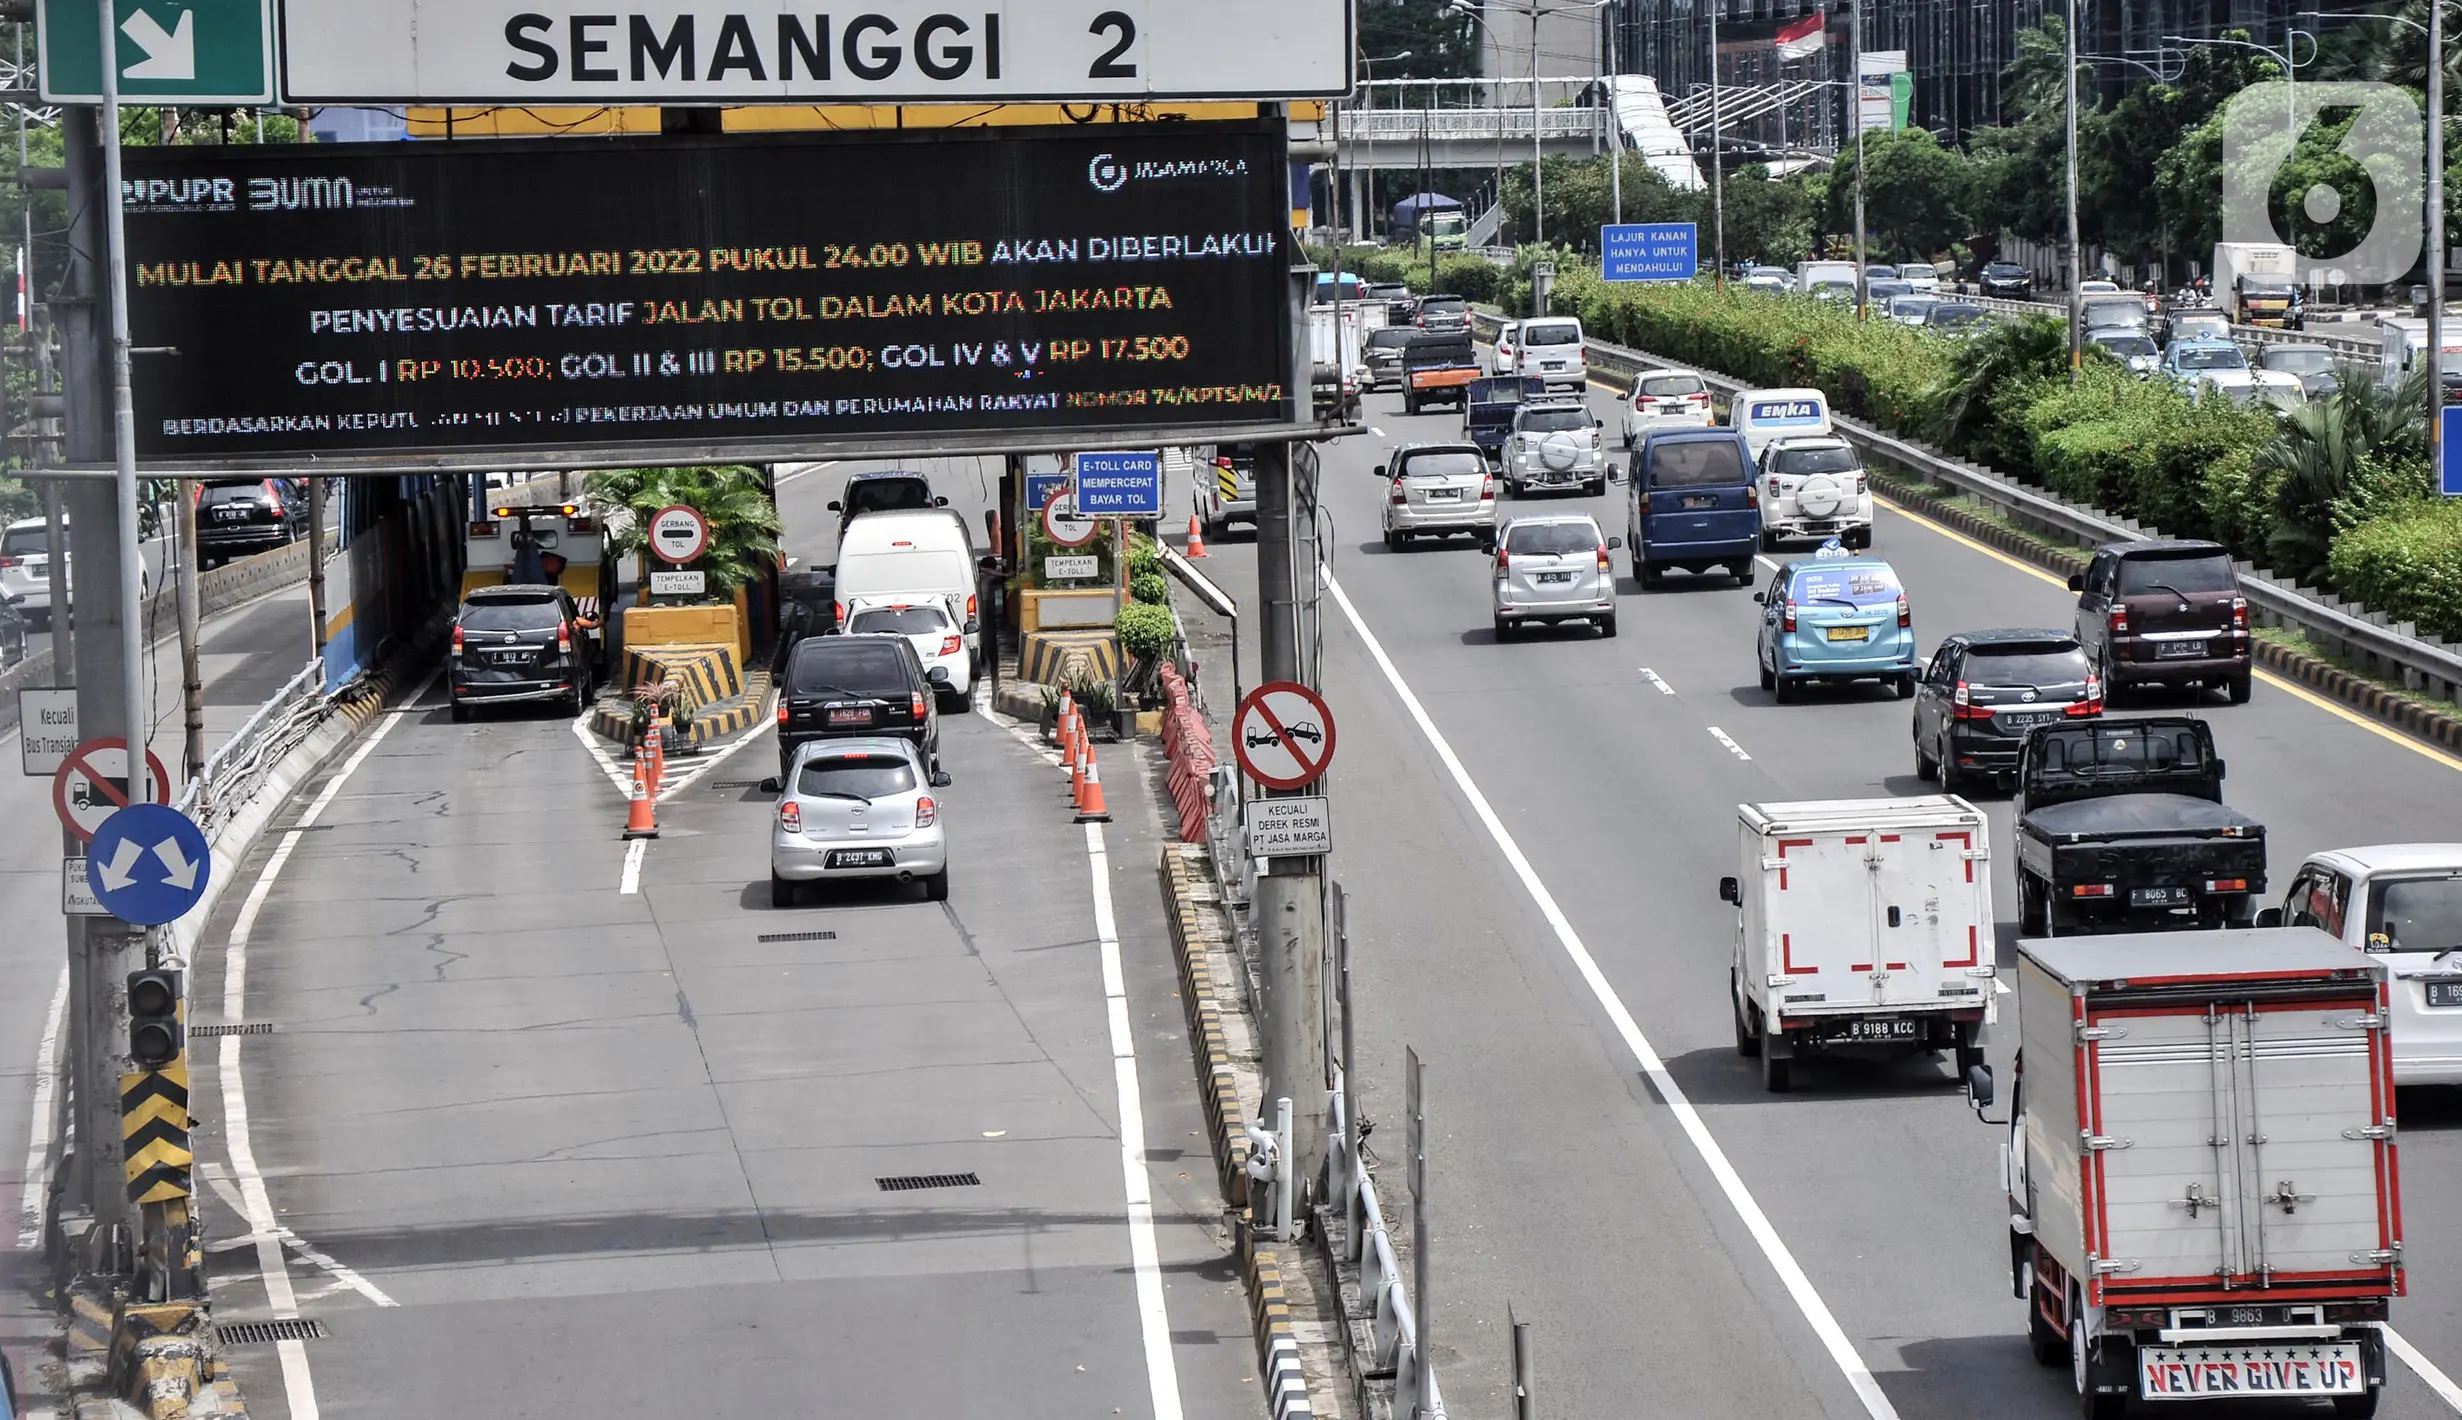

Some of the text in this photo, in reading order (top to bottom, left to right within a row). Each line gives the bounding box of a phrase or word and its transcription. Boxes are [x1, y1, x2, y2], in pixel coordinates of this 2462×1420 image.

[505, 11, 1137, 82] SEMANGGI 2
[1611, 231, 1687, 243] LAJUR KANAN
[1611, 246, 1688, 258] HANYA UNTUK
[136, 259, 243, 287] MULAI
[250, 255, 408, 284] TANGGAL
[413, 254, 452, 280] 26
[460, 251, 621, 278] FEBRUARI
[629, 248, 702, 274] 2022
[709, 245, 817, 271] PUKUL
[824, 243, 910, 269] 24.00
[916, 240, 984, 266] WIB
[991, 238, 1078, 262] AKAN
[1616, 262, 1683, 273] MENDAHULUI
[310, 285, 1173, 333] PENYESUAIAN TARIF JALAN TOL DALAM KOTA JAKARTA
[296, 361, 372, 384] GOL.
[396, 359, 441, 382] RP
[561, 353, 626, 379] GOL
[633, 352, 650, 377] II
[659, 350, 680, 377] &
[689, 349, 715, 375] III
[724, 349, 766, 372] RP
[773, 345, 875, 373] 15.500;
[881, 344, 945, 368] GOL
[953, 342, 983, 366] IV
[990, 340, 1013, 366] &
[1020, 342, 1041, 364] V
[1050, 339, 1091, 361] RP
[1100, 335, 1190, 361] 17.500
[162, 415, 330, 435] BERDASARKAN
[783, 400, 829, 417] DAN
[835, 395, 973, 415] PERUMAHAN
[980, 392, 1060, 411] RAKYAT
[1761, 402, 1811, 419] EMKA
[1083, 461, 1152, 471] E-TOLL CARD
[1083, 478, 1153, 488] MEMPERCEPAT
[1090, 494, 1146, 504] BAYAR TOL
[41, 707, 75, 725] Kecuali
[26, 737, 40, 753] Bus
[1268, 804, 1307, 816] KECUALI
[1258, 818, 1319, 830] DEREK RESMI
[1253, 831, 1326, 844] PT JASA MARGA
[2431, 986, 2438, 997] B
[1853, 1022, 1913, 1035] B 9188 KCC
[2208, 1310, 2216, 1324] B
[2232, 1308, 2262, 1323] 9863
[2147, 1361, 2355, 1392] NEVER GIVE UP
